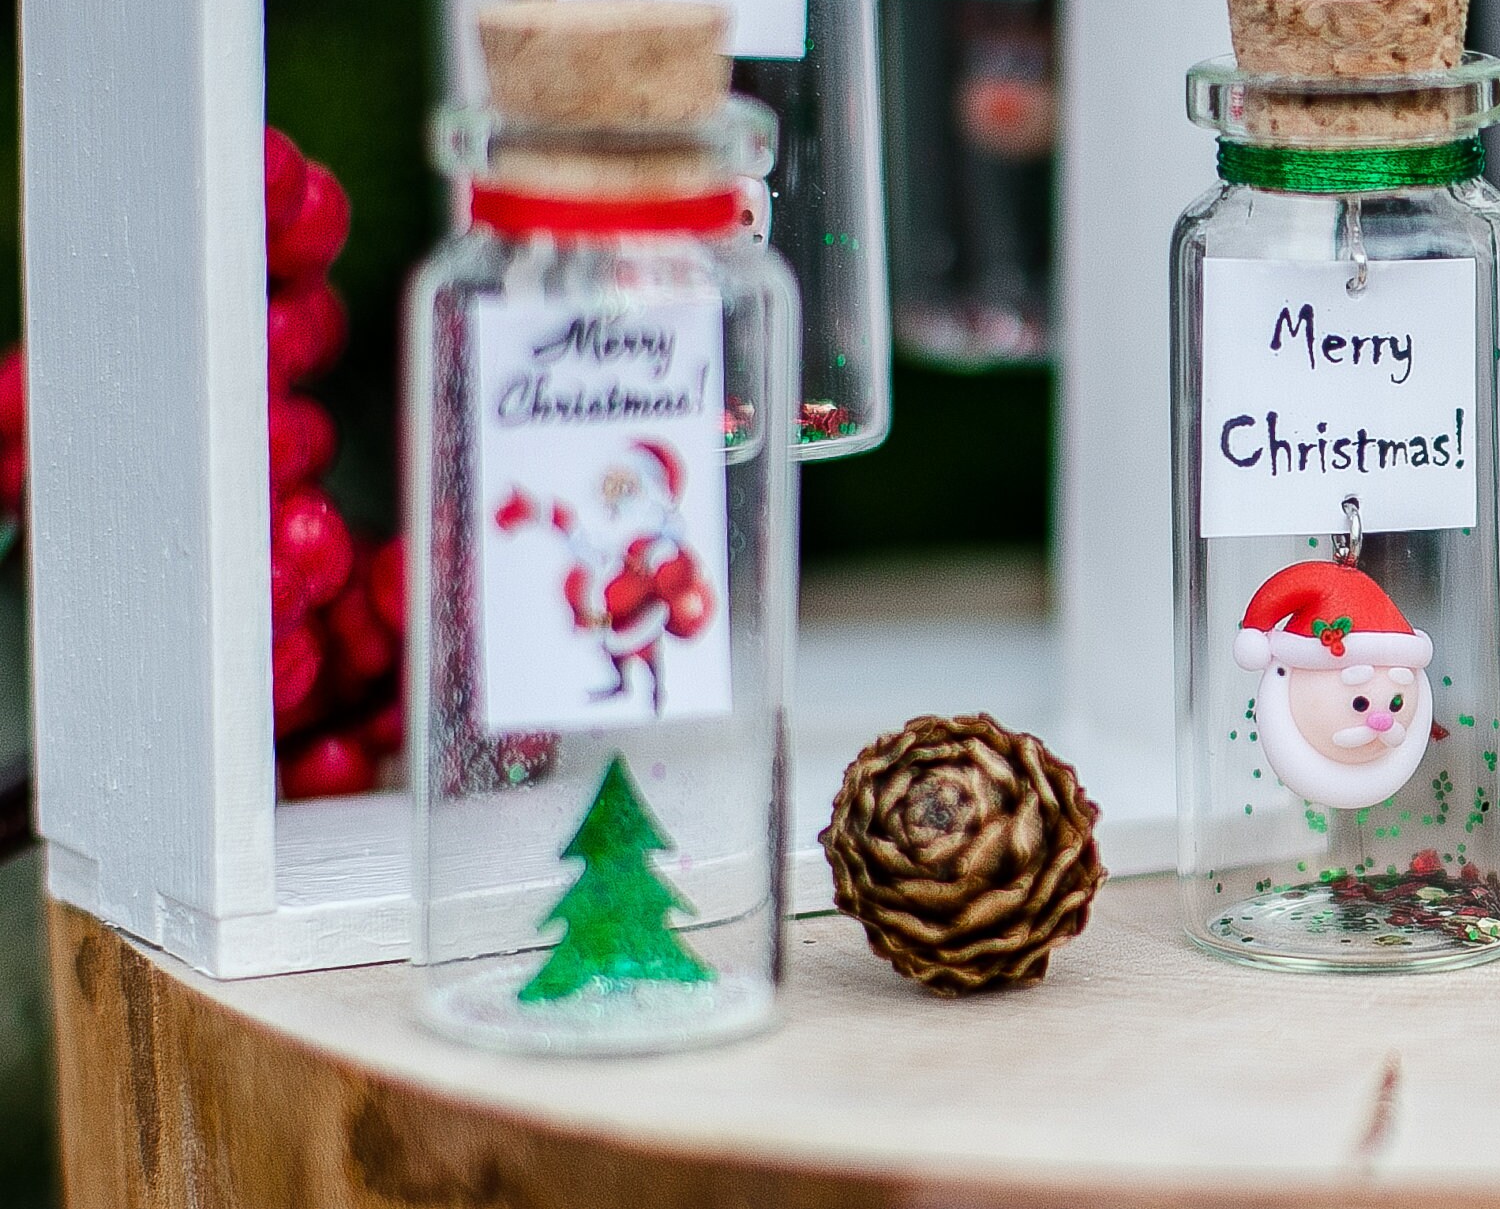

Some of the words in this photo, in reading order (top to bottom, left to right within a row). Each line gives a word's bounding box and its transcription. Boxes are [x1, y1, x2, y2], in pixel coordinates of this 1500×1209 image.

[532, 316, 676, 380] Merry
[1270, 303, 1413, 384] Merry
[497, 358, 710, 426] Christmas!
[1220, 407, 1465, 476] Christmas!
